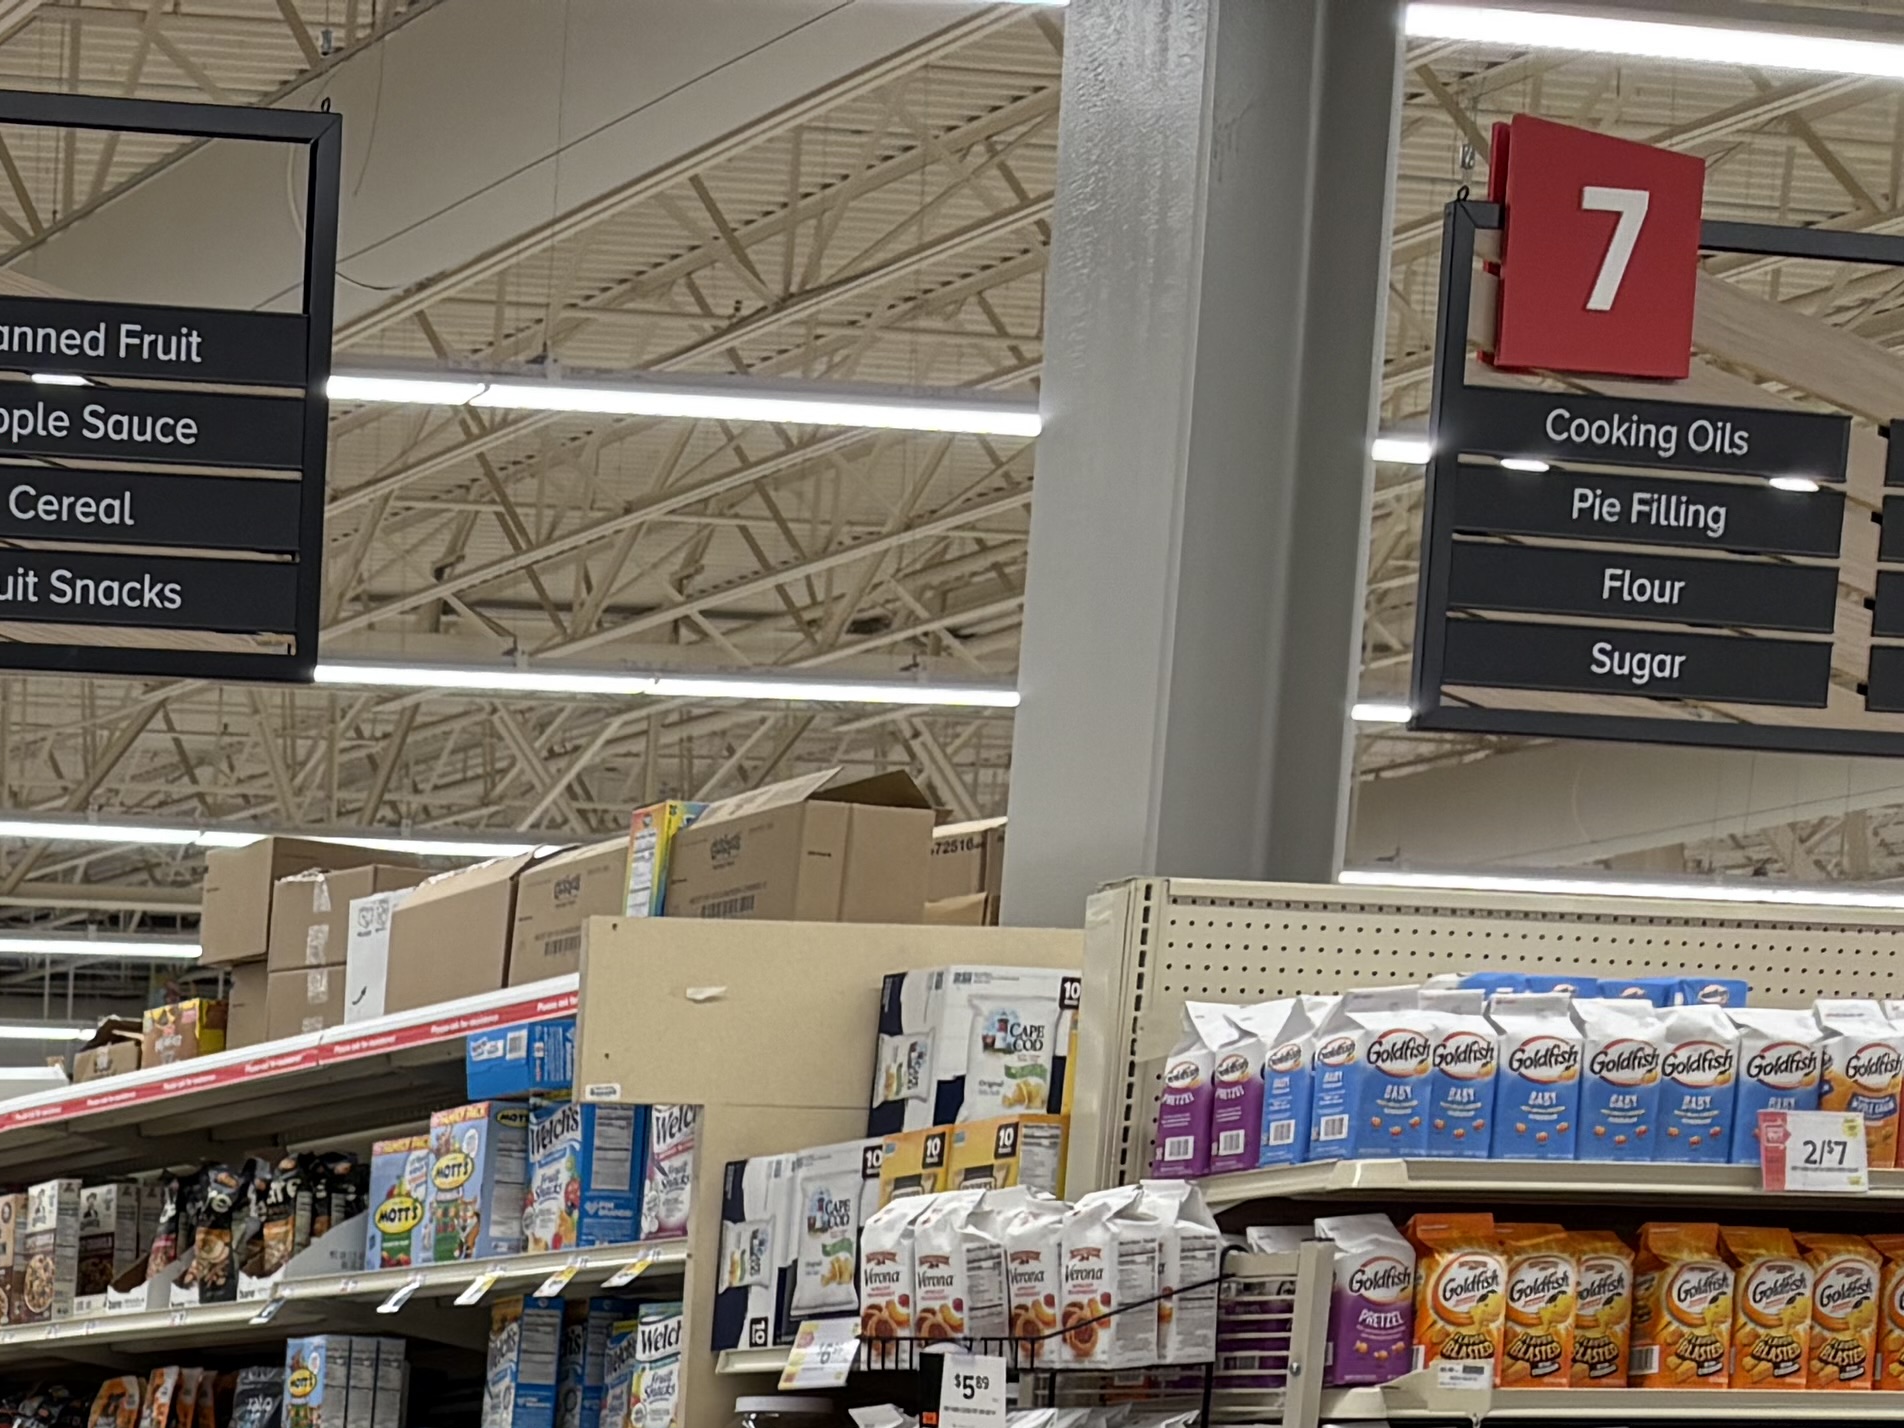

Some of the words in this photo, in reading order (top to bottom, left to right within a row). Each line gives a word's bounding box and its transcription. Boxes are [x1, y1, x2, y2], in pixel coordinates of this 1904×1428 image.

[1581, 186, 1649, 311] 7
[118, 323, 202, 363] Fruit
[81, 405, 198, 447] Sauce
[1546, 408, 1677, 456] Cooking
[1688, 420, 1749, 456] Oils
[8, 486, 134, 527] Cereal
[1572, 488, 1621, 523] Pie
[1630, 493, 1726, 538] Filling
[49, 571, 182, 610] Snacks
[1602, 569, 1685, 605] Flour
[1591, 643, 1686, 684] Sugar
[1064, 982, 1080, 999] 10
[1010, 1021, 1045, 1040] CAPE
[1012, 1036, 1044, 1053] COD
[1508, 1044, 1578, 1072] Goldfish
[1384, 1086, 1412, 1100] BABY
[530, 1107, 580, 1155] Welch's
[926, 1136, 940, 1157] 10
[378, 1204, 420, 1224] MOTT'S
[865, 1269, 901, 1287] Verona
[1358, 1309, 1403, 1326] PRETZEL
[1512, 1344, 1562, 1361] BLASTED
